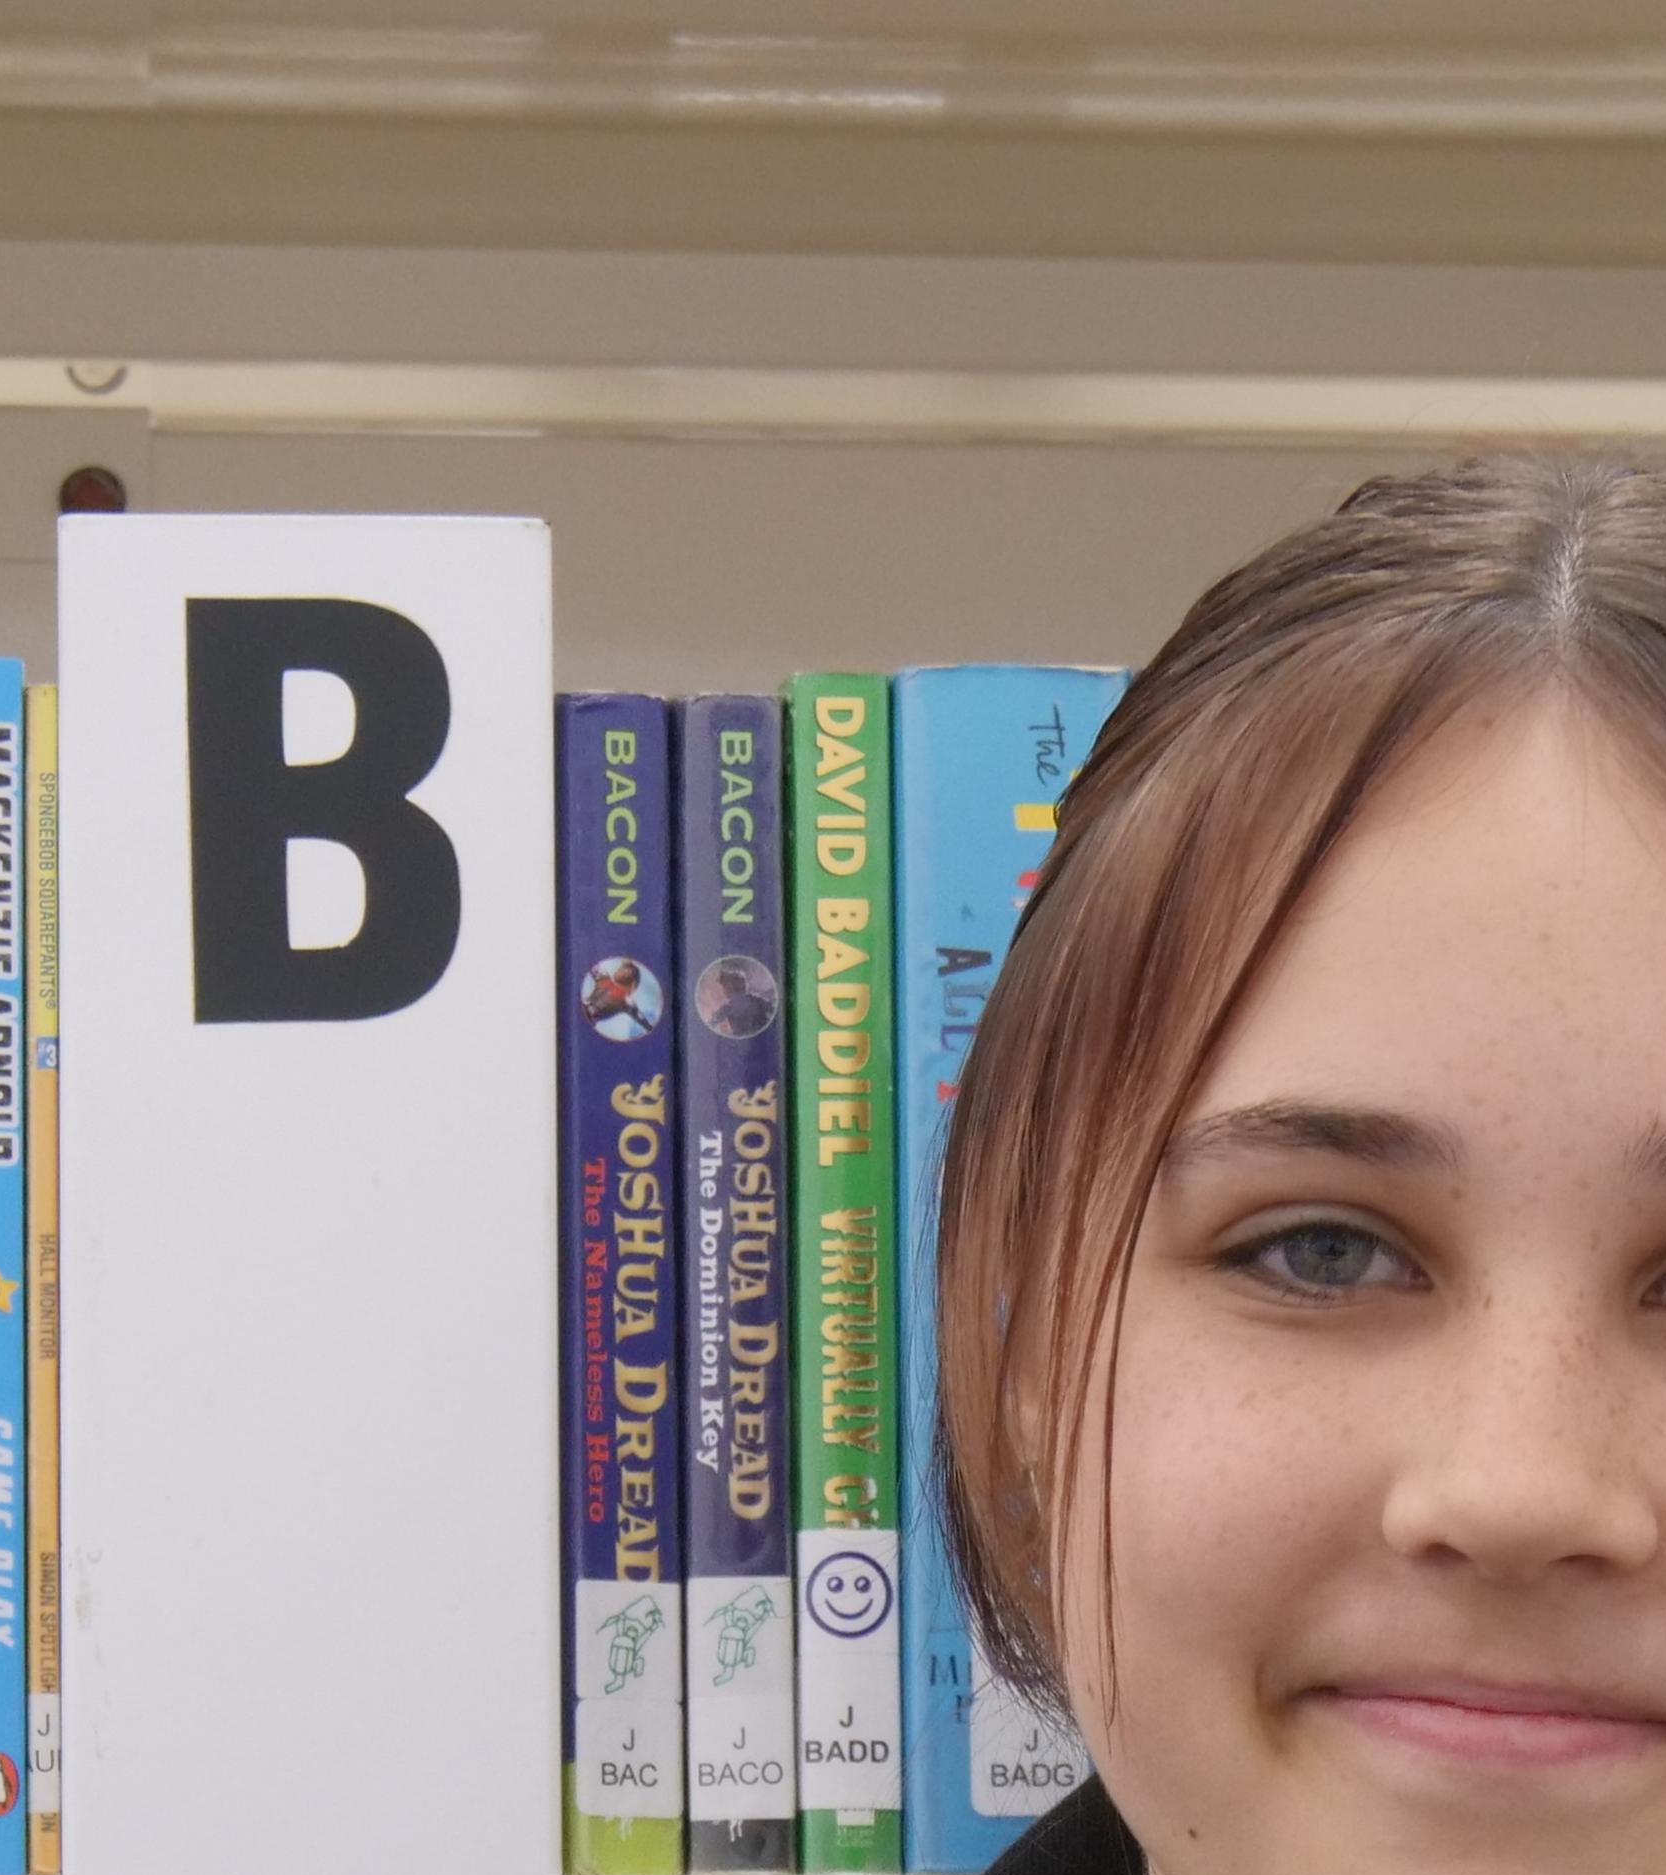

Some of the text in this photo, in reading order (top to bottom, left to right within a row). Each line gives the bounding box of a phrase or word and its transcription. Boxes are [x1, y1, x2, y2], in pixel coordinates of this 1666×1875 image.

[38, 771, 55, 872] SPONGEBOB
[185, 597, 461, 1025] B
[605, 729, 637, 925] BACON
[720, 729, 754, 924] BACON
[1028, 703, 1066, 787] The
[815, 696, 872, 1168] DAVID BADDIEL
[39, 1234, 57, 1360] HALL MONITOR
[583, 1157, 610, 1524] The Nameless Hero
[610, 1073, 668, 1583] JOSHUA DREAD
[699, 1130, 724, 1474] The Dominion Key
[727, 1078, 779, 1521] JOSHUA DREAD
[820, 1206, 882, 1454] VIRTUALLY
[804, 1740, 890, 1763] BADD
[990, 1763, 1075, 1788] BADG
